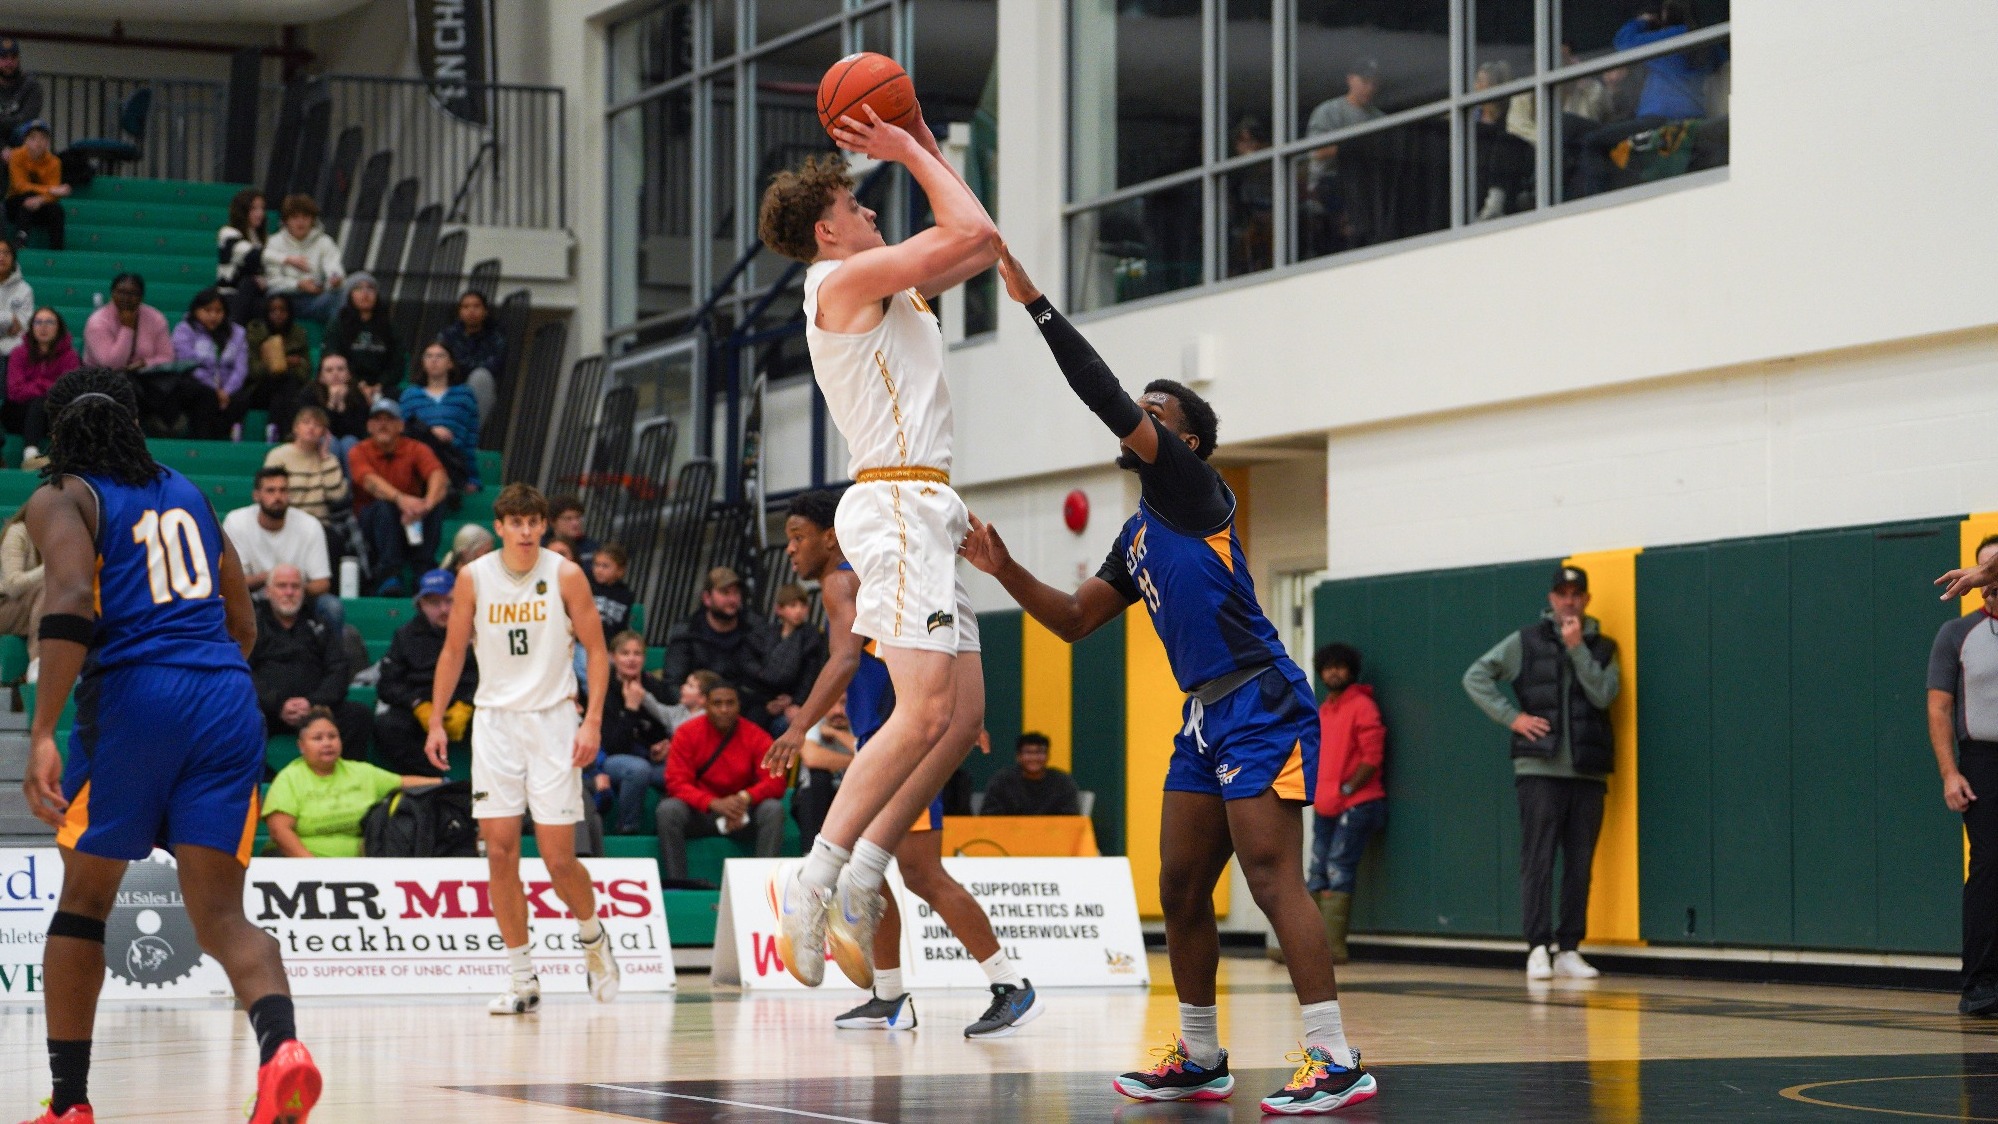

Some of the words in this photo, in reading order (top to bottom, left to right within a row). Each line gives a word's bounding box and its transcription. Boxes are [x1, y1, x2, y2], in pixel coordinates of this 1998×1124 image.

[132, 507, 213, 605] 10
[488, 600, 548, 624] UNBC
[508, 628, 529, 656] 13
[252, 880, 386, 921] MR
[971, 882, 1061, 897] SUPPORTER
[989, 903, 1070, 917] ATHLETICS
[1075, 903, 1105, 917] AND
[313, 965, 386, 977] SUPPORTER
[391, 965, 409, 976] OF
[414, 964, 452, 976] UNBC
[625, 962, 664, 974] GAME
